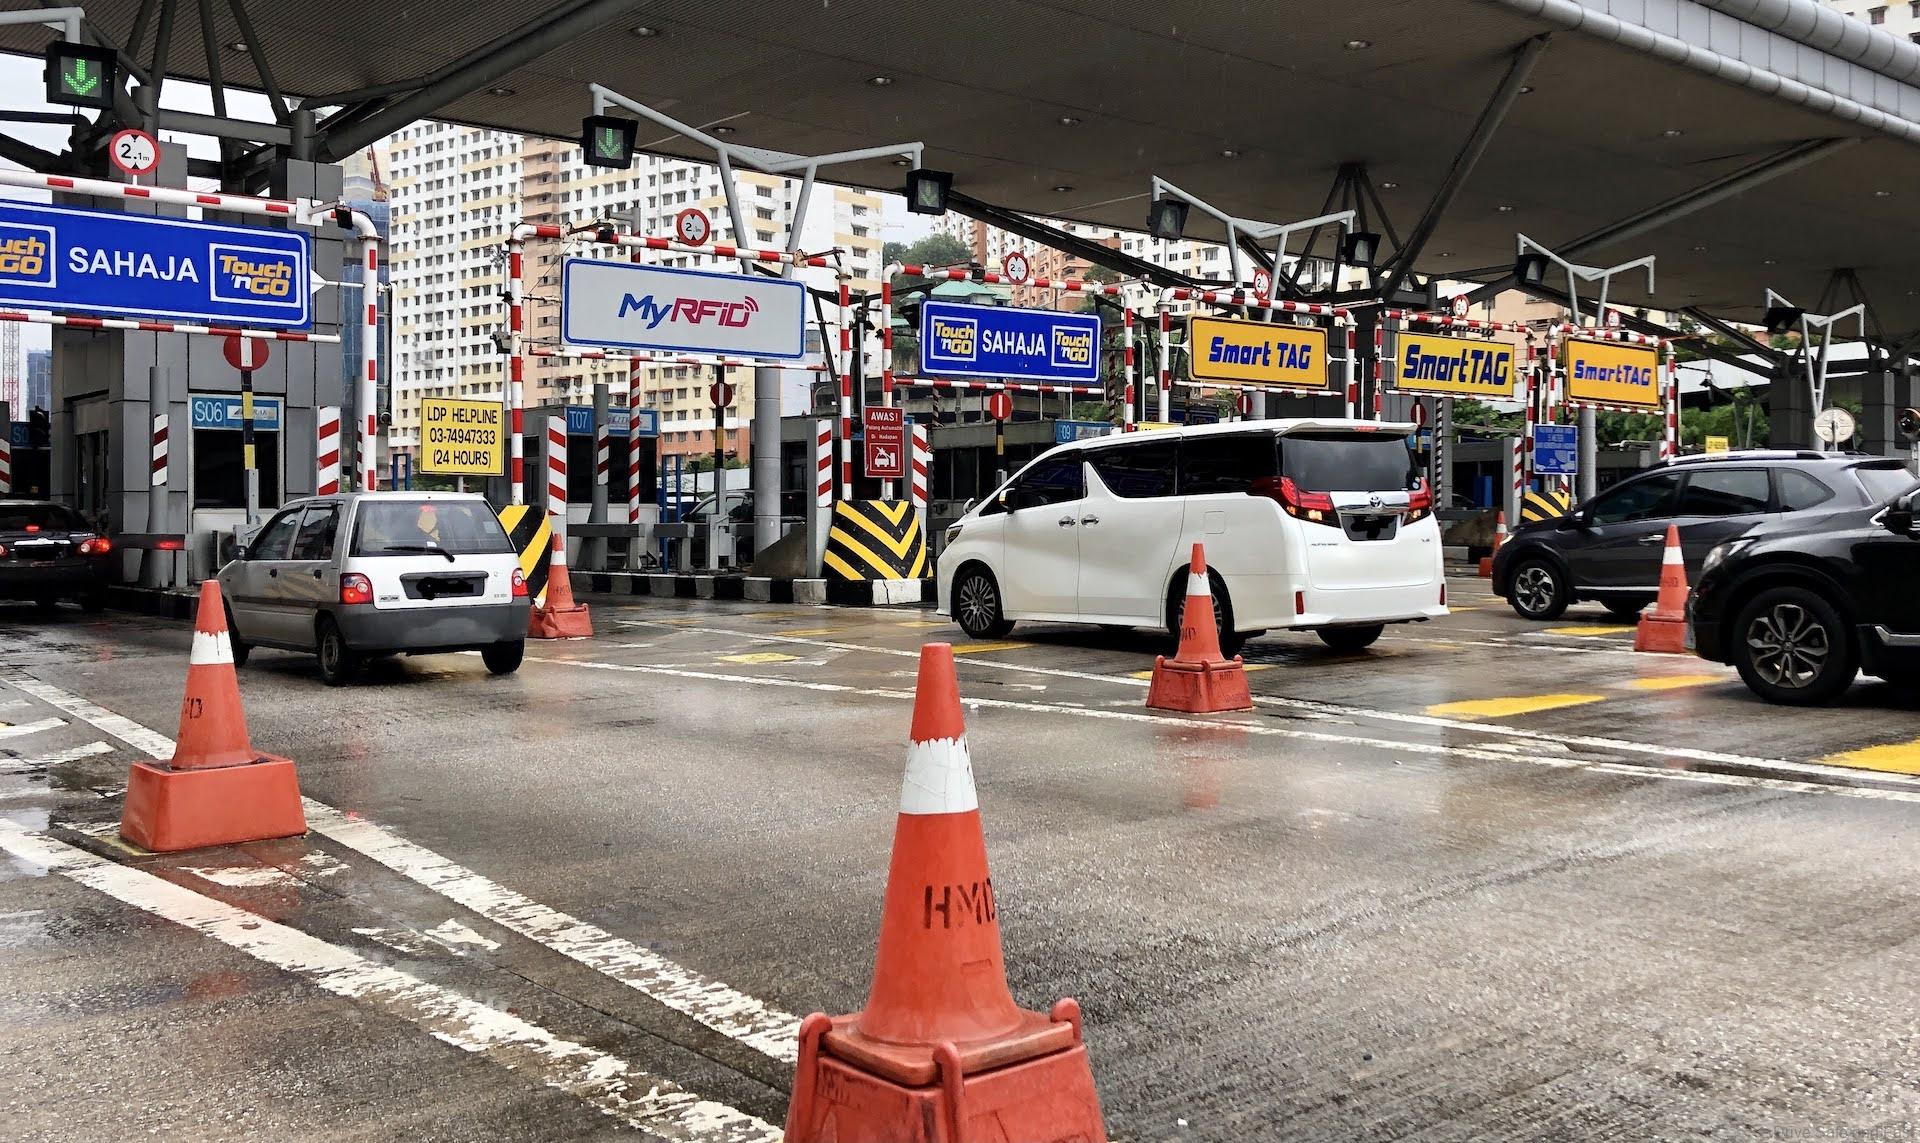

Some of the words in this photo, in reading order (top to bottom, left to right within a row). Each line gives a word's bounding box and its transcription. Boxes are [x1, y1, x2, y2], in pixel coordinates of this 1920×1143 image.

[0, 236, 46, 257] uch
[68, 246, 200, 284] SAHAJA
[219, 254, 292, 279] Touch
[935, 321, 974, 338] Touch
[982, 329, 1047, 357] SAHAJA
[1055, 331, 1090, 348] Touch
[1208, 336, 1271, 367] Smart
[1277, 342, 1312, 370] TAG
[194, 401, 223, 422] S06
[427, 406, 447, 422] LDP
[452, 407, 498, 424] HELPLINE
[569, 411, 588, 429] T07
[870, 411, 899, 422] AWAS!
[429, 427, 496, 445] 03-74947333
[433, 449, 450, 467] (24
[453, 450, 491, 468] HOURS)
